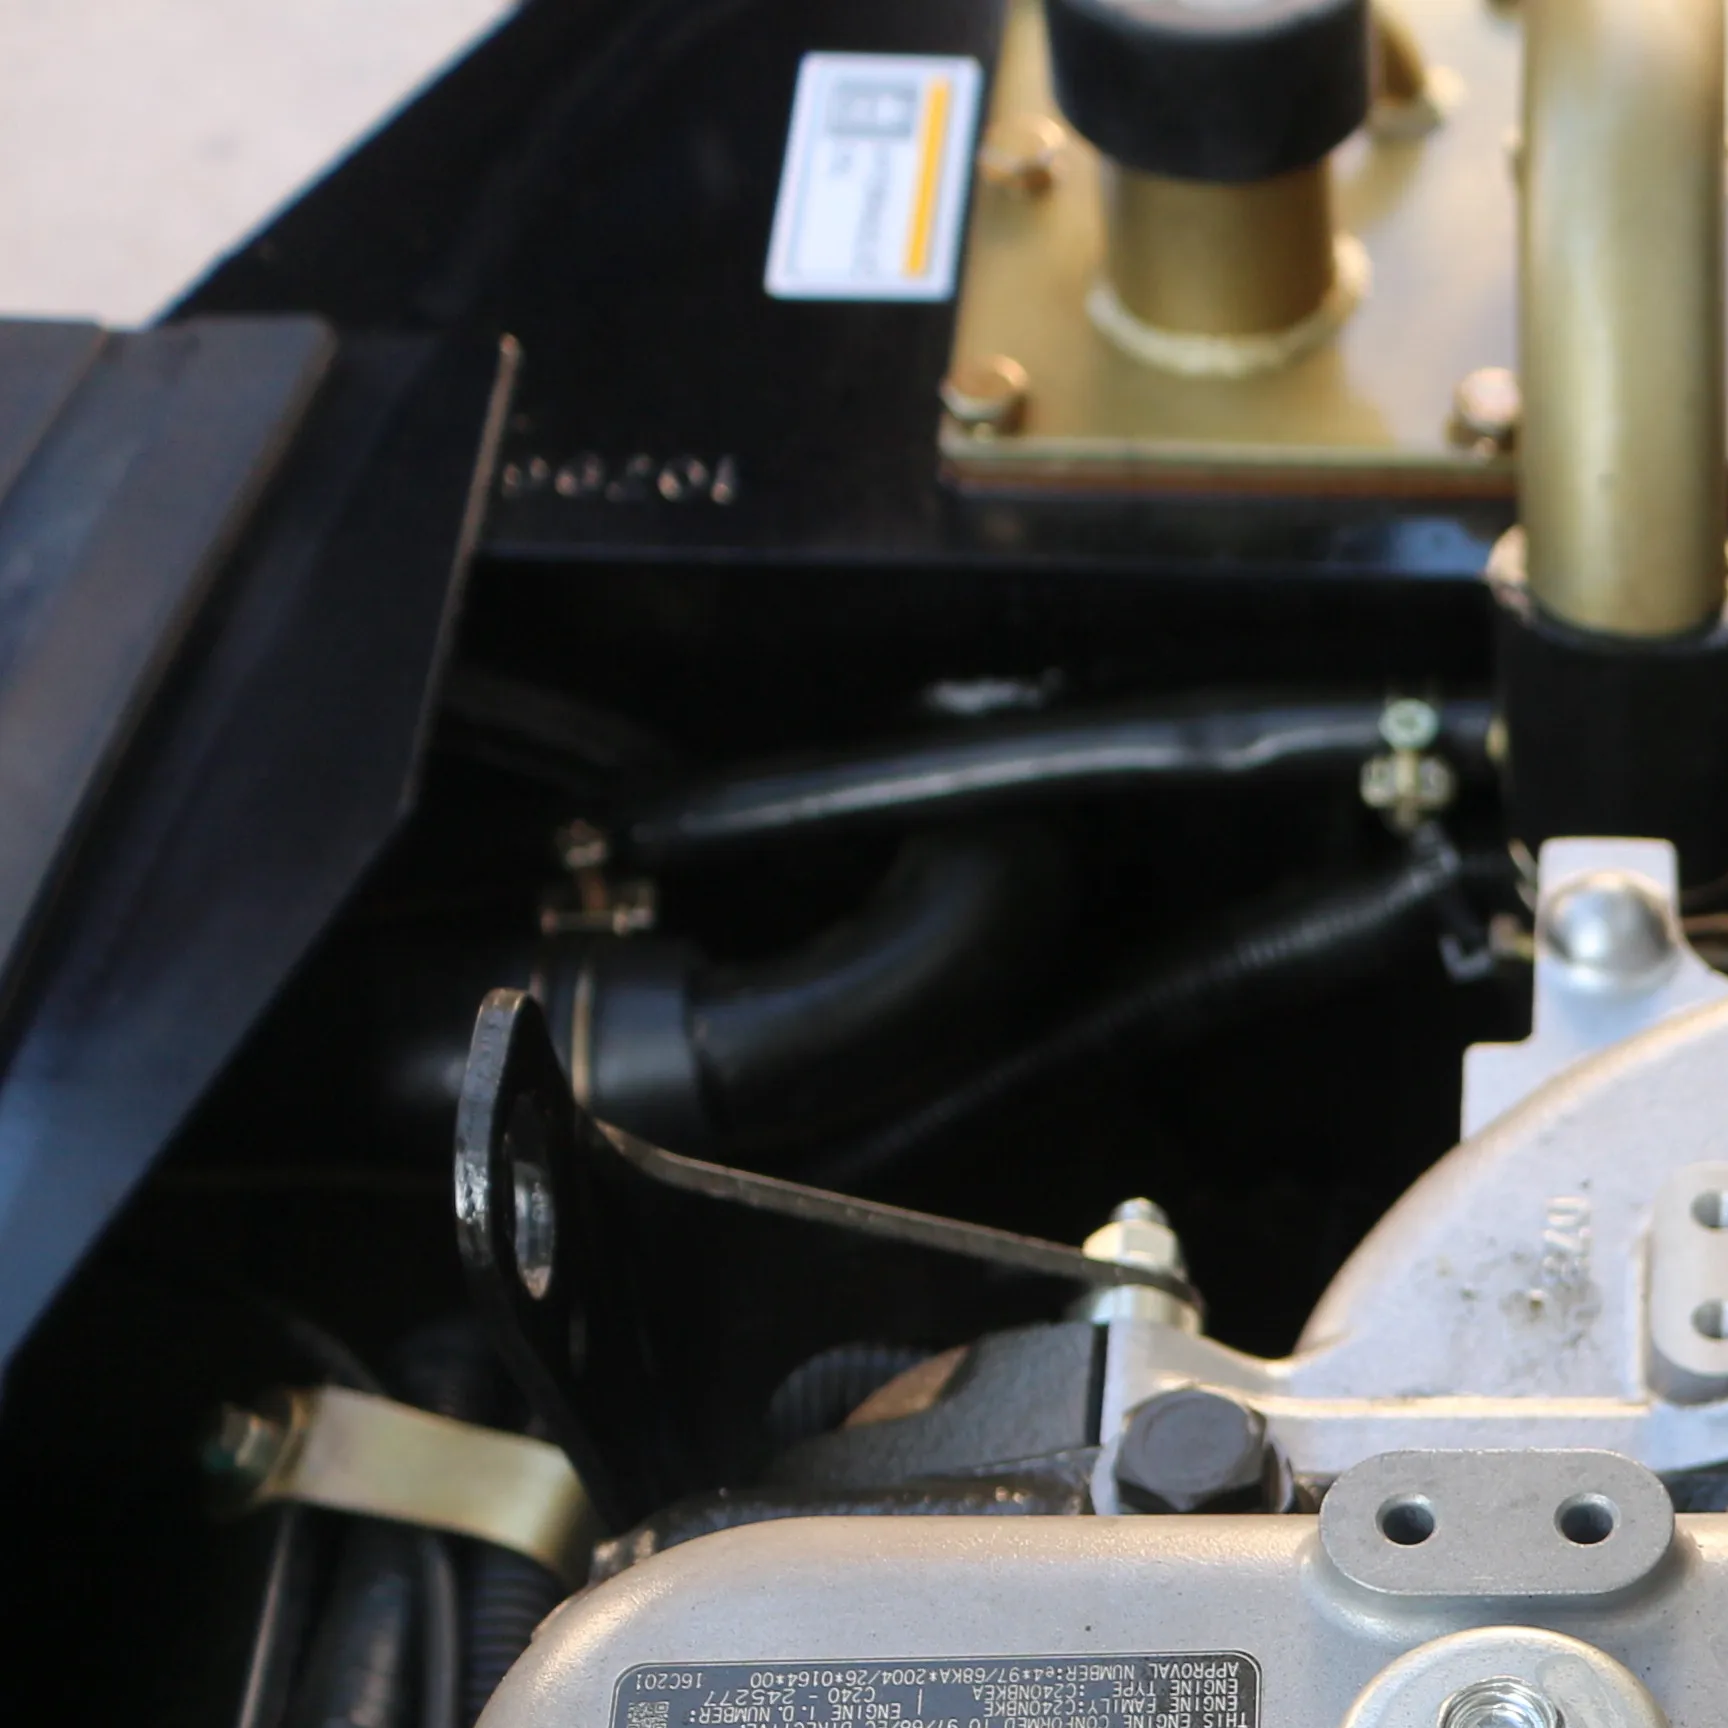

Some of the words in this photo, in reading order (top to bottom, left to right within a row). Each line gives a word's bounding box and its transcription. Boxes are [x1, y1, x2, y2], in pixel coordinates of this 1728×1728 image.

[1149, 1662, 1239, 1681] APPROVAL
[636, 1672, 703, 1691] 16C201
[1112, 1680, 1156, 1698] TYPE
[1170, 1679, 1239, 1696] ENGINE
[704, 1689, 796, 1707] 245277
[828, 1688, 875, 1704] C240
[1170, 1696, 1238, 1713] ENGINE
[832, 1703, 901, 1721] ENGINE
[1204, 1711, 1249, 1728] THIS
